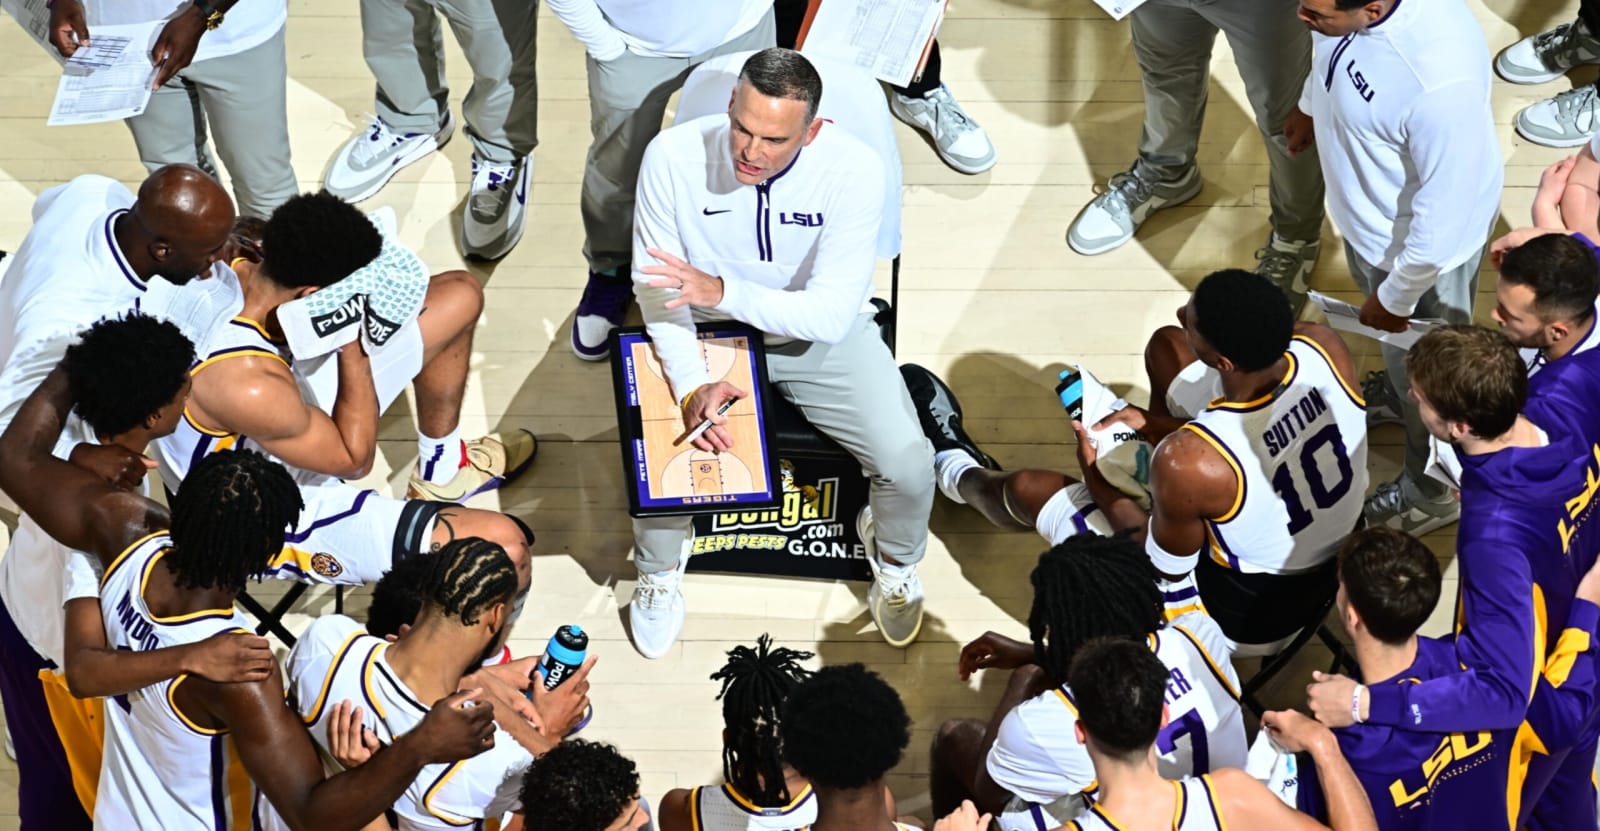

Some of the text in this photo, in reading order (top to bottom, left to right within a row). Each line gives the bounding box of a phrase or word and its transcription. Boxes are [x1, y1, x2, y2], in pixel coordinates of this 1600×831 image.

[1347, 59, 1375, 103] LSU
[779, 212, 824, 227] LSU
[1262, 386, 1327, 458] SUTTON
[1271, 423, 1354, 537] 10
[682, 494, 738, 504] TIGERS
[691, 535, 787, 554] EEPS PESTS
[801, 523, 844, 540] .com
[1389, 730, 1492, 807] LSU
